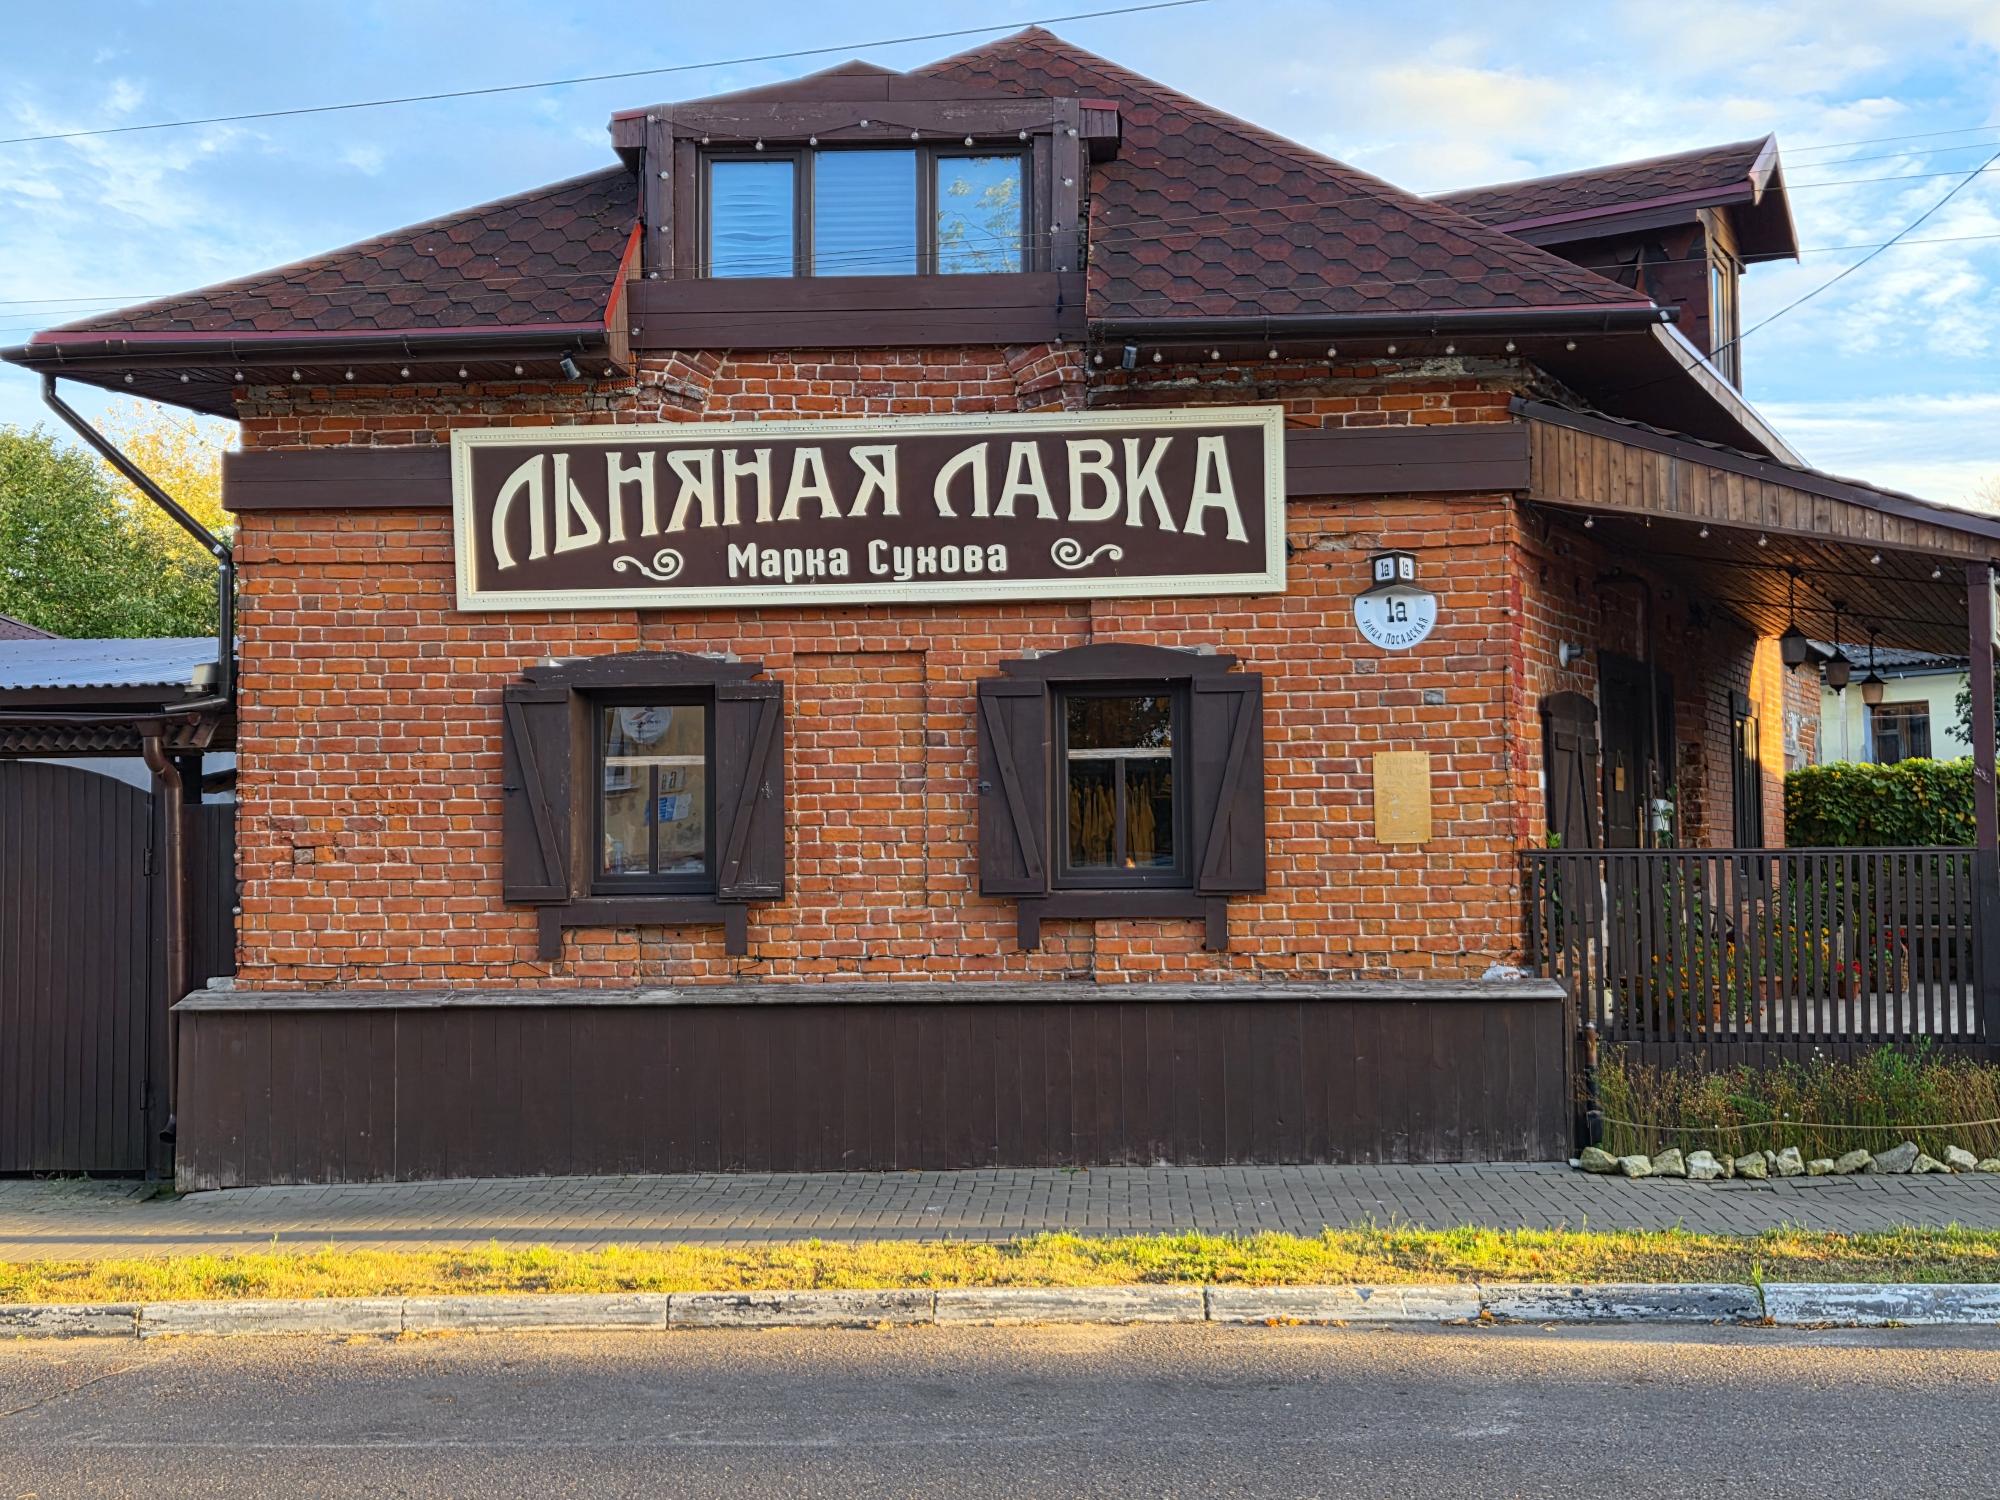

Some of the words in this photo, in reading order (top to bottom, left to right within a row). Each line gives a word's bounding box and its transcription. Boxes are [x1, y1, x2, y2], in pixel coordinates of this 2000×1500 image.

[492, 444, 901, 571] ЛЬНЯНАЯ
[934, 435, 1248, 544] ЛАВКА
[727, 543, 849, 584] Марка
[868, 539, 1008, 581] Сухова
[1386, 597, 1408, 622] 1а
